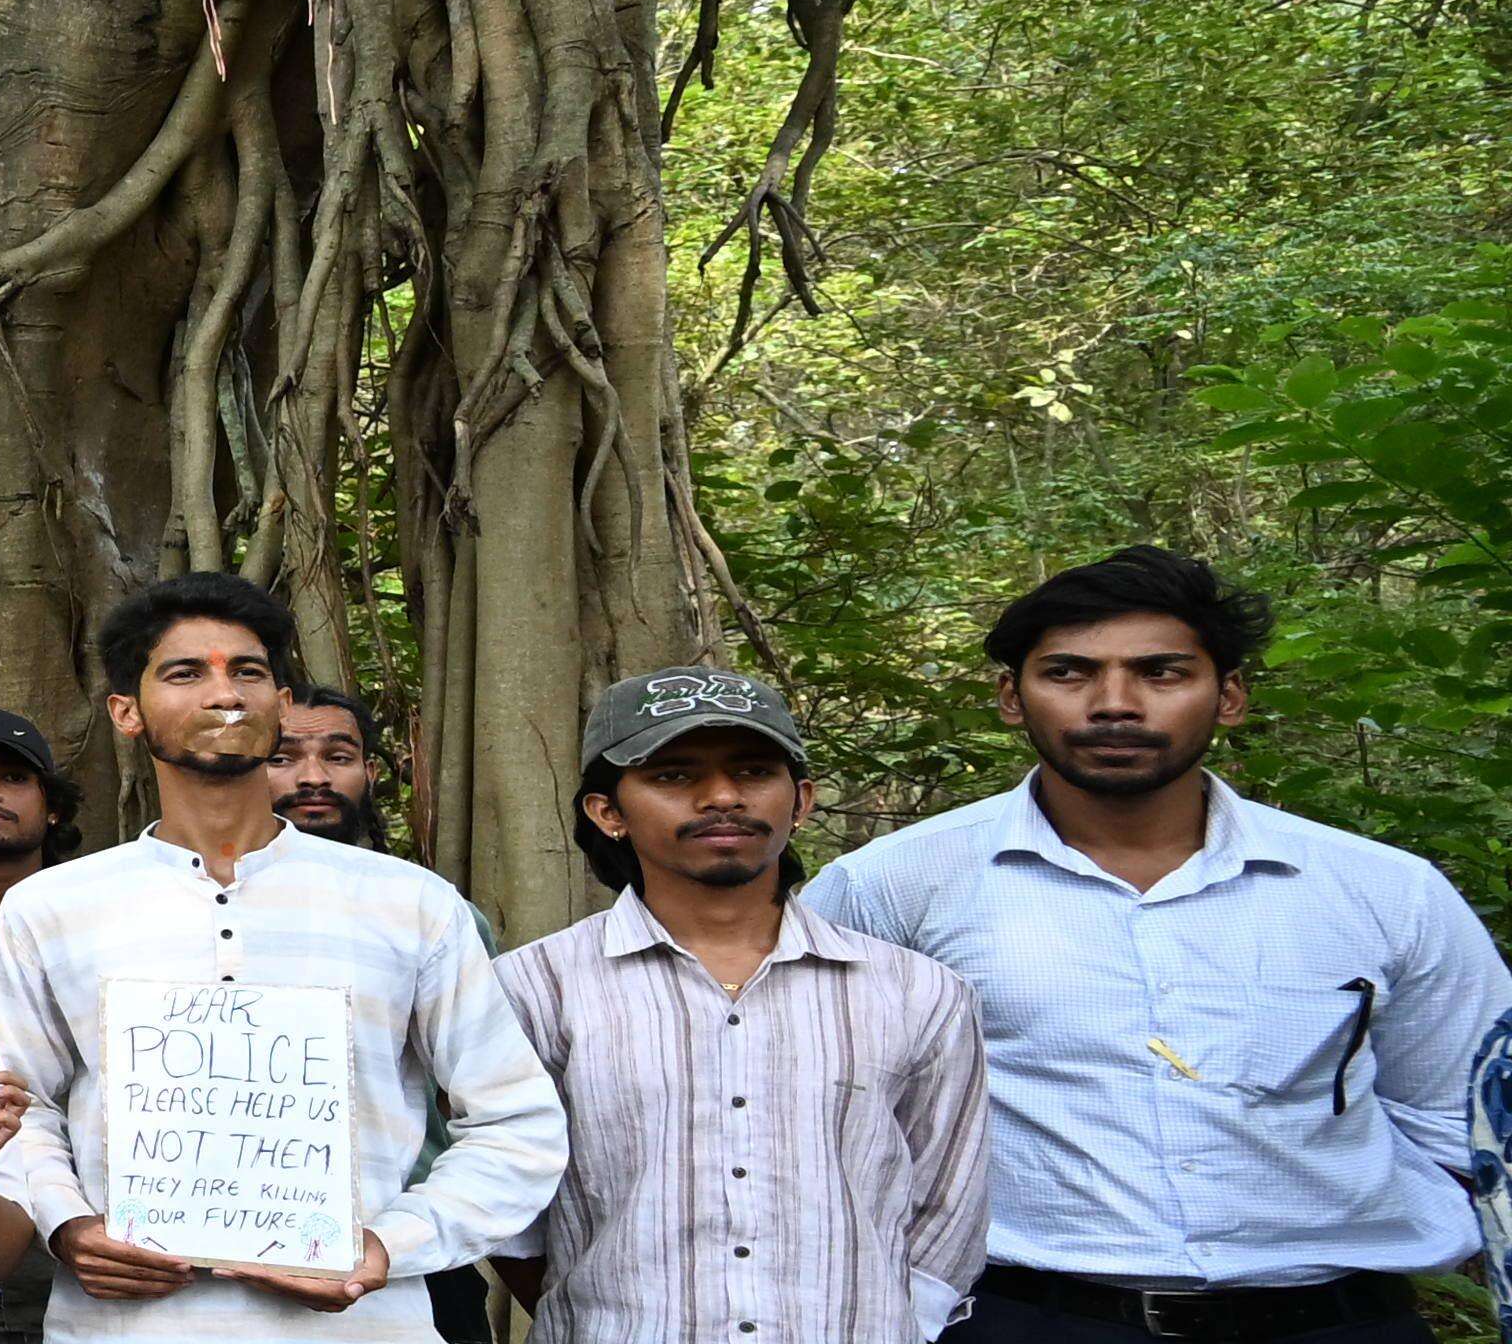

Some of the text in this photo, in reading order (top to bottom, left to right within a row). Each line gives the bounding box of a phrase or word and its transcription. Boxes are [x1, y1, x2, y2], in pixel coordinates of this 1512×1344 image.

[163, 987, 263, 1027] DEAR
[124, 1083, 218, 1116] PLEASE
[230, 1090, 296, 1119] HELP
[133, 1129, 215, 1167] NOT
[120, 1175, 328, 1205] THEY ARE KILLING
[147, 1208, 186, 1225] OUR
